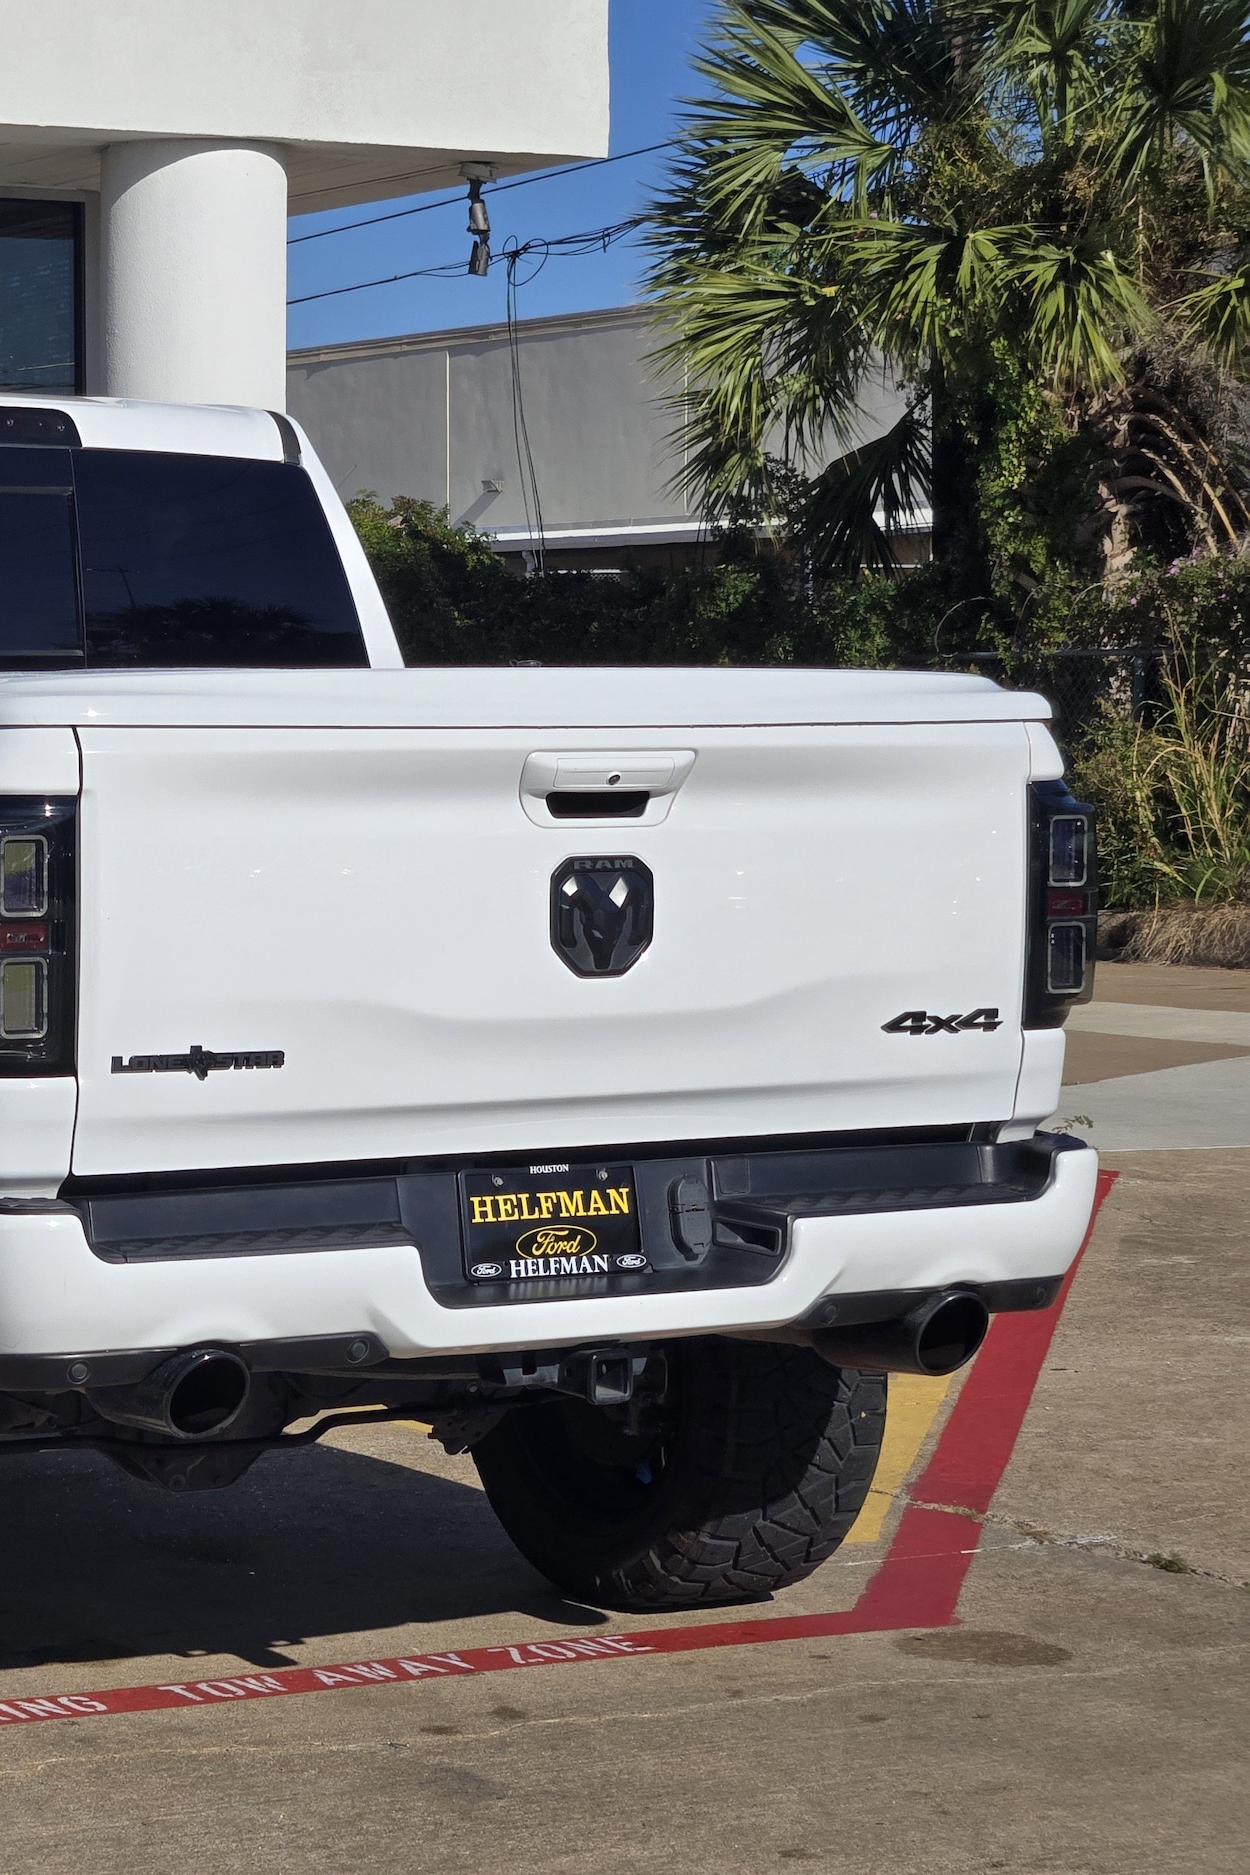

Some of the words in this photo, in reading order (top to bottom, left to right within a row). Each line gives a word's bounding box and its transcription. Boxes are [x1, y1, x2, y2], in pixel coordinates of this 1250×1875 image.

[573, 860, 634, 870] RAM
[111, 1054, 191, 1074] LONE
[214, 1050, 285, 1070] STAR
[529, 1164, 569, 1174] HOUSTON
[470, 1188, 630, 1223] HELFMAN
[532, 1230, 582, 1256] Ford
[476, 1265, 497, 1275] Ford
[510, 1255, 610, 1278] HELFMAN
[622, 1256, 643, 1266] Ford
[158, 1675, 287, 1701] TOW
[312, 1653, 475, 1687] AWAY
[487, 1635, 656, 1665] ZONE
